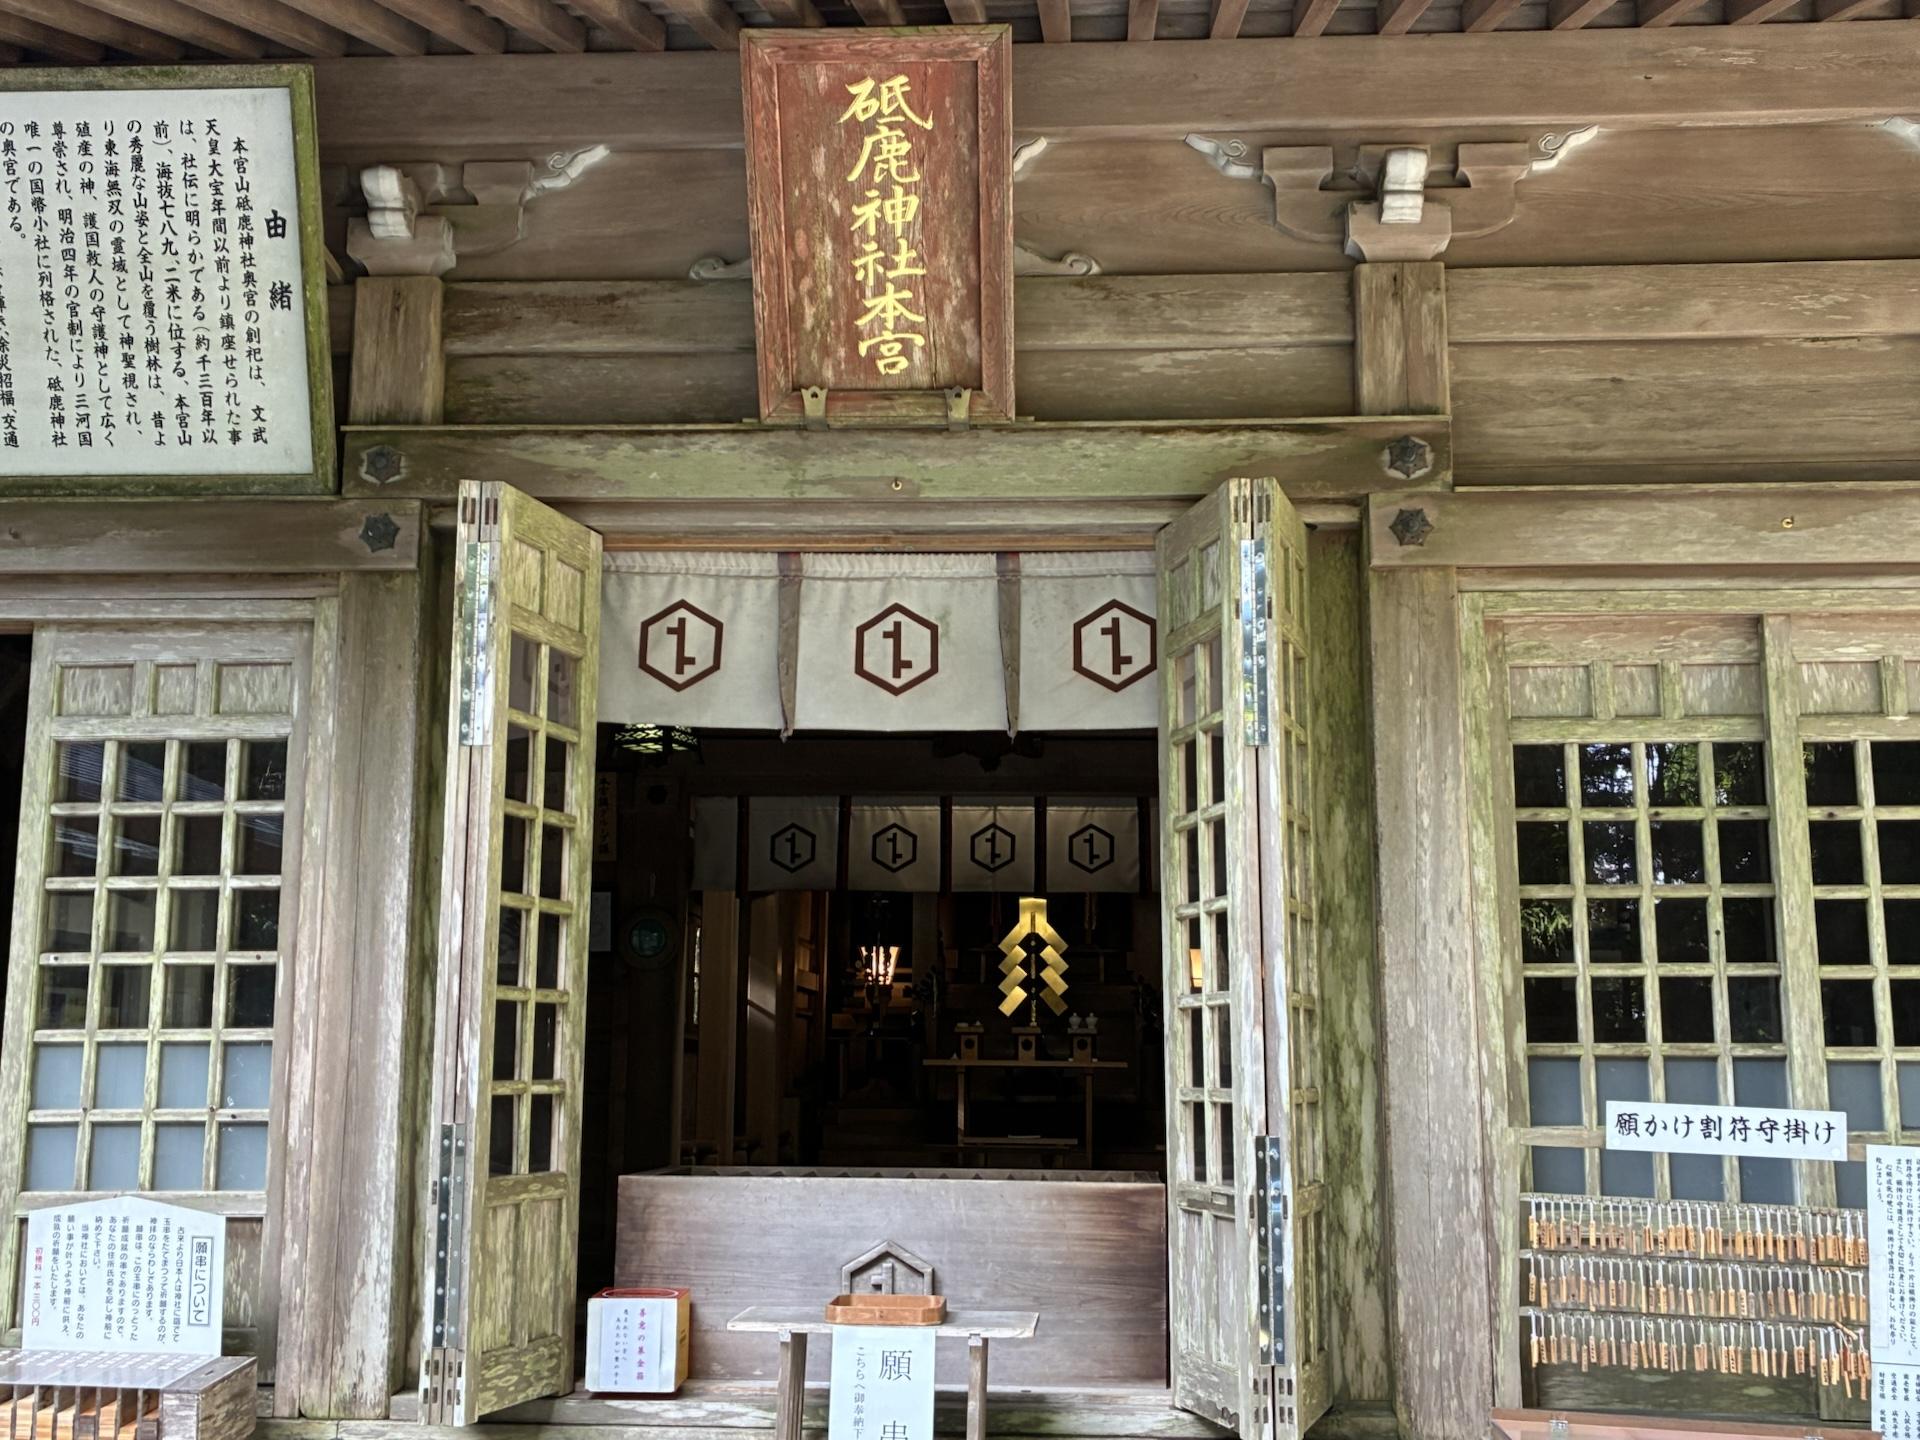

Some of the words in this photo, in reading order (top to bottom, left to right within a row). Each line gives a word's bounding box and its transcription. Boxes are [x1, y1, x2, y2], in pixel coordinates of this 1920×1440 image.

[837, 74, 934, 376] 砥鹿神社本宮
[1615, 1112, 1837, 1145] 願かけ割符守掛け
[193, 1241, 208, 1323] 願串について
